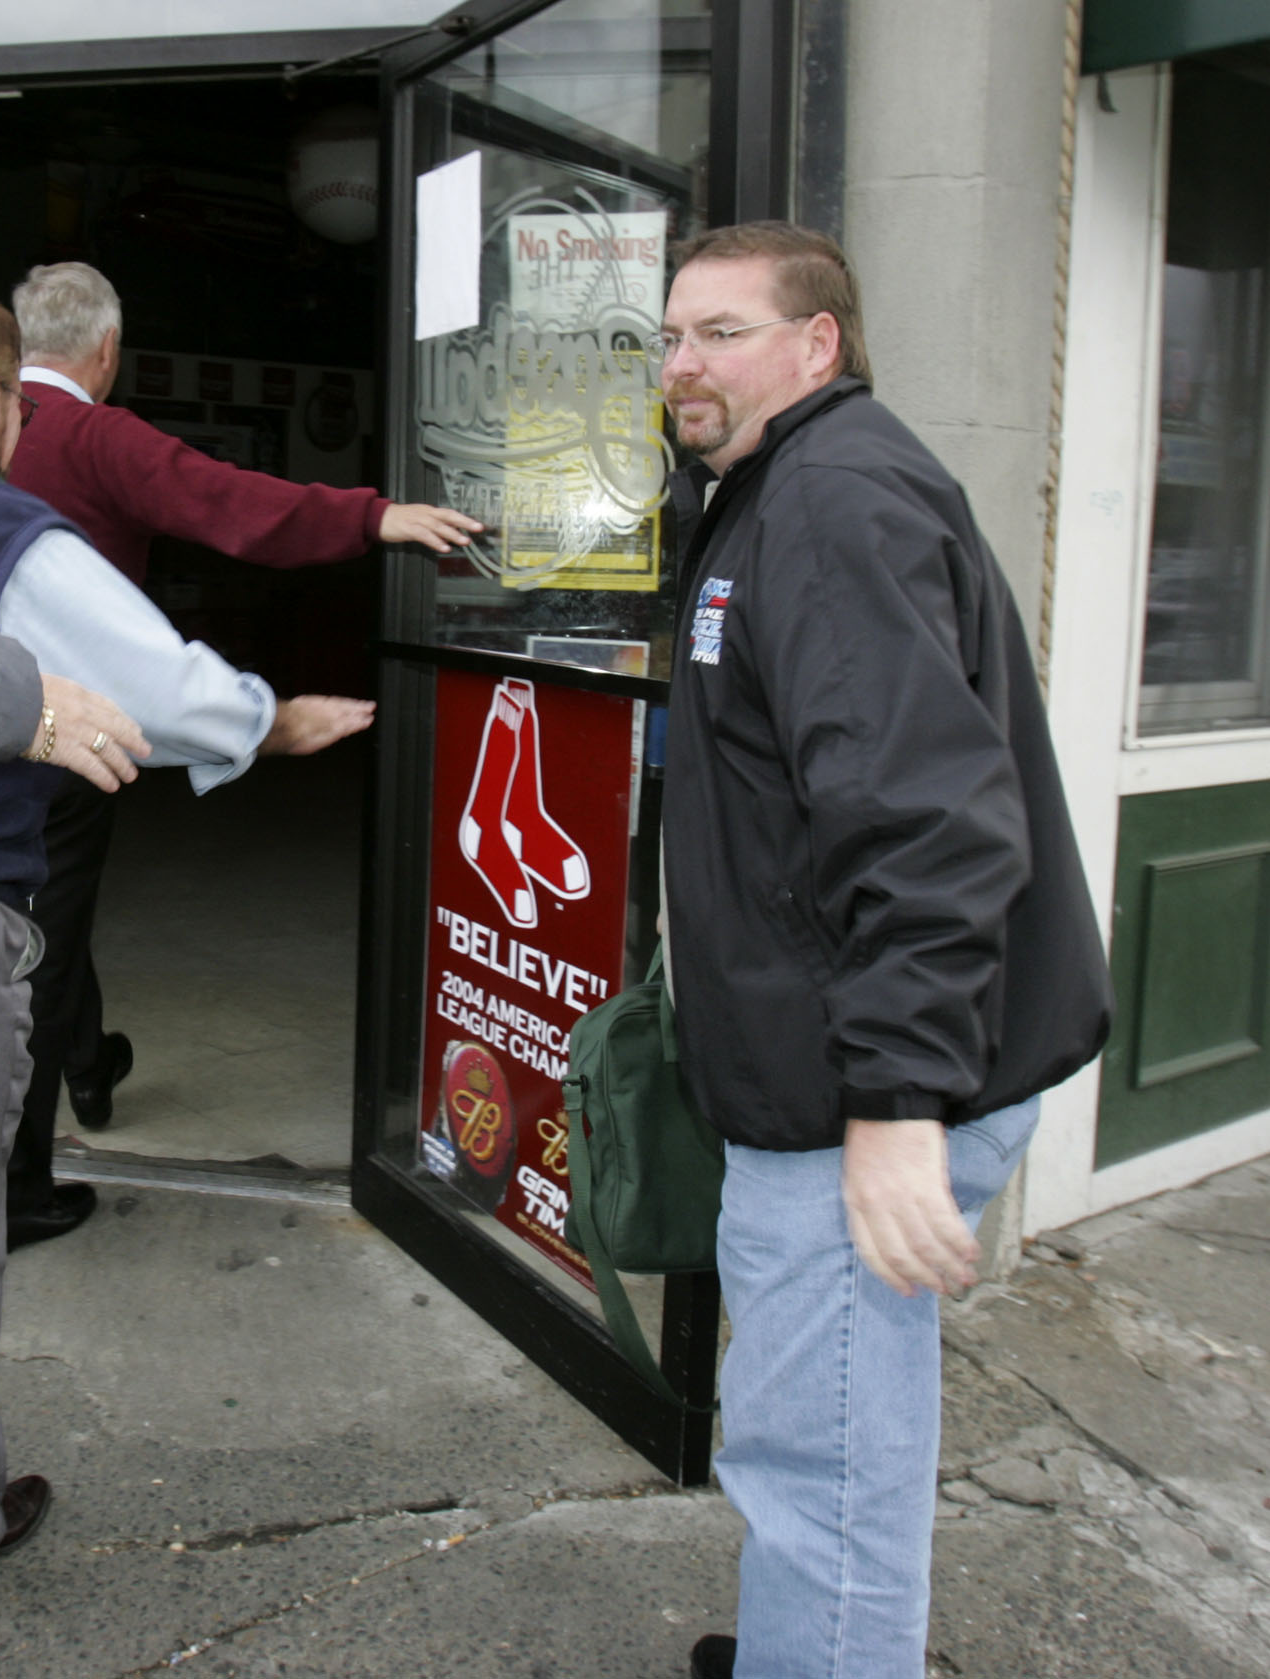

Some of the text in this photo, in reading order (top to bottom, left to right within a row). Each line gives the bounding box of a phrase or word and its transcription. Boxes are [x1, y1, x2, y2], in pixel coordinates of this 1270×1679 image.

[517, 227, 660, 268] No Smoking
[437, 905, 608, 1014] "BELIEVE"
[441, 970, 484, 1010] 2004
[436, 993, 569, 1082] LEAGUE CHAM
